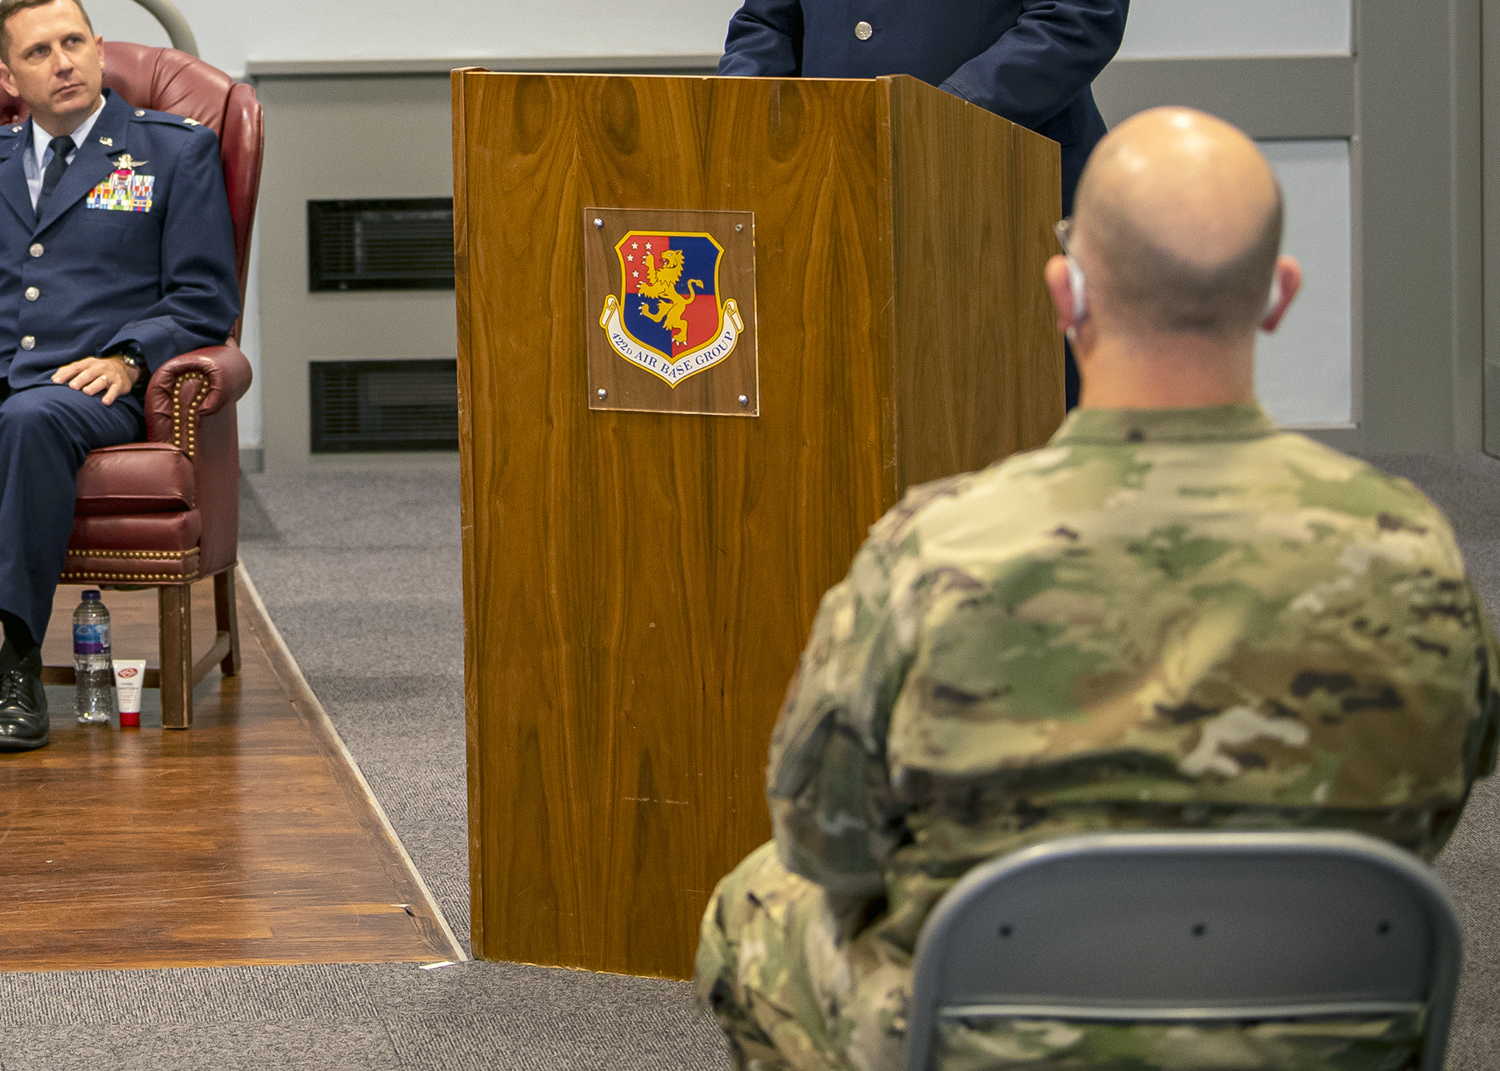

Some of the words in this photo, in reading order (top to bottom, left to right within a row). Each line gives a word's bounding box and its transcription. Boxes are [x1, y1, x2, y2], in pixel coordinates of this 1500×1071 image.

[634, 351, 658, 368] AIR
[660, 360, 693, 378] BASE
[695, 331, 733, 365] GROUP
